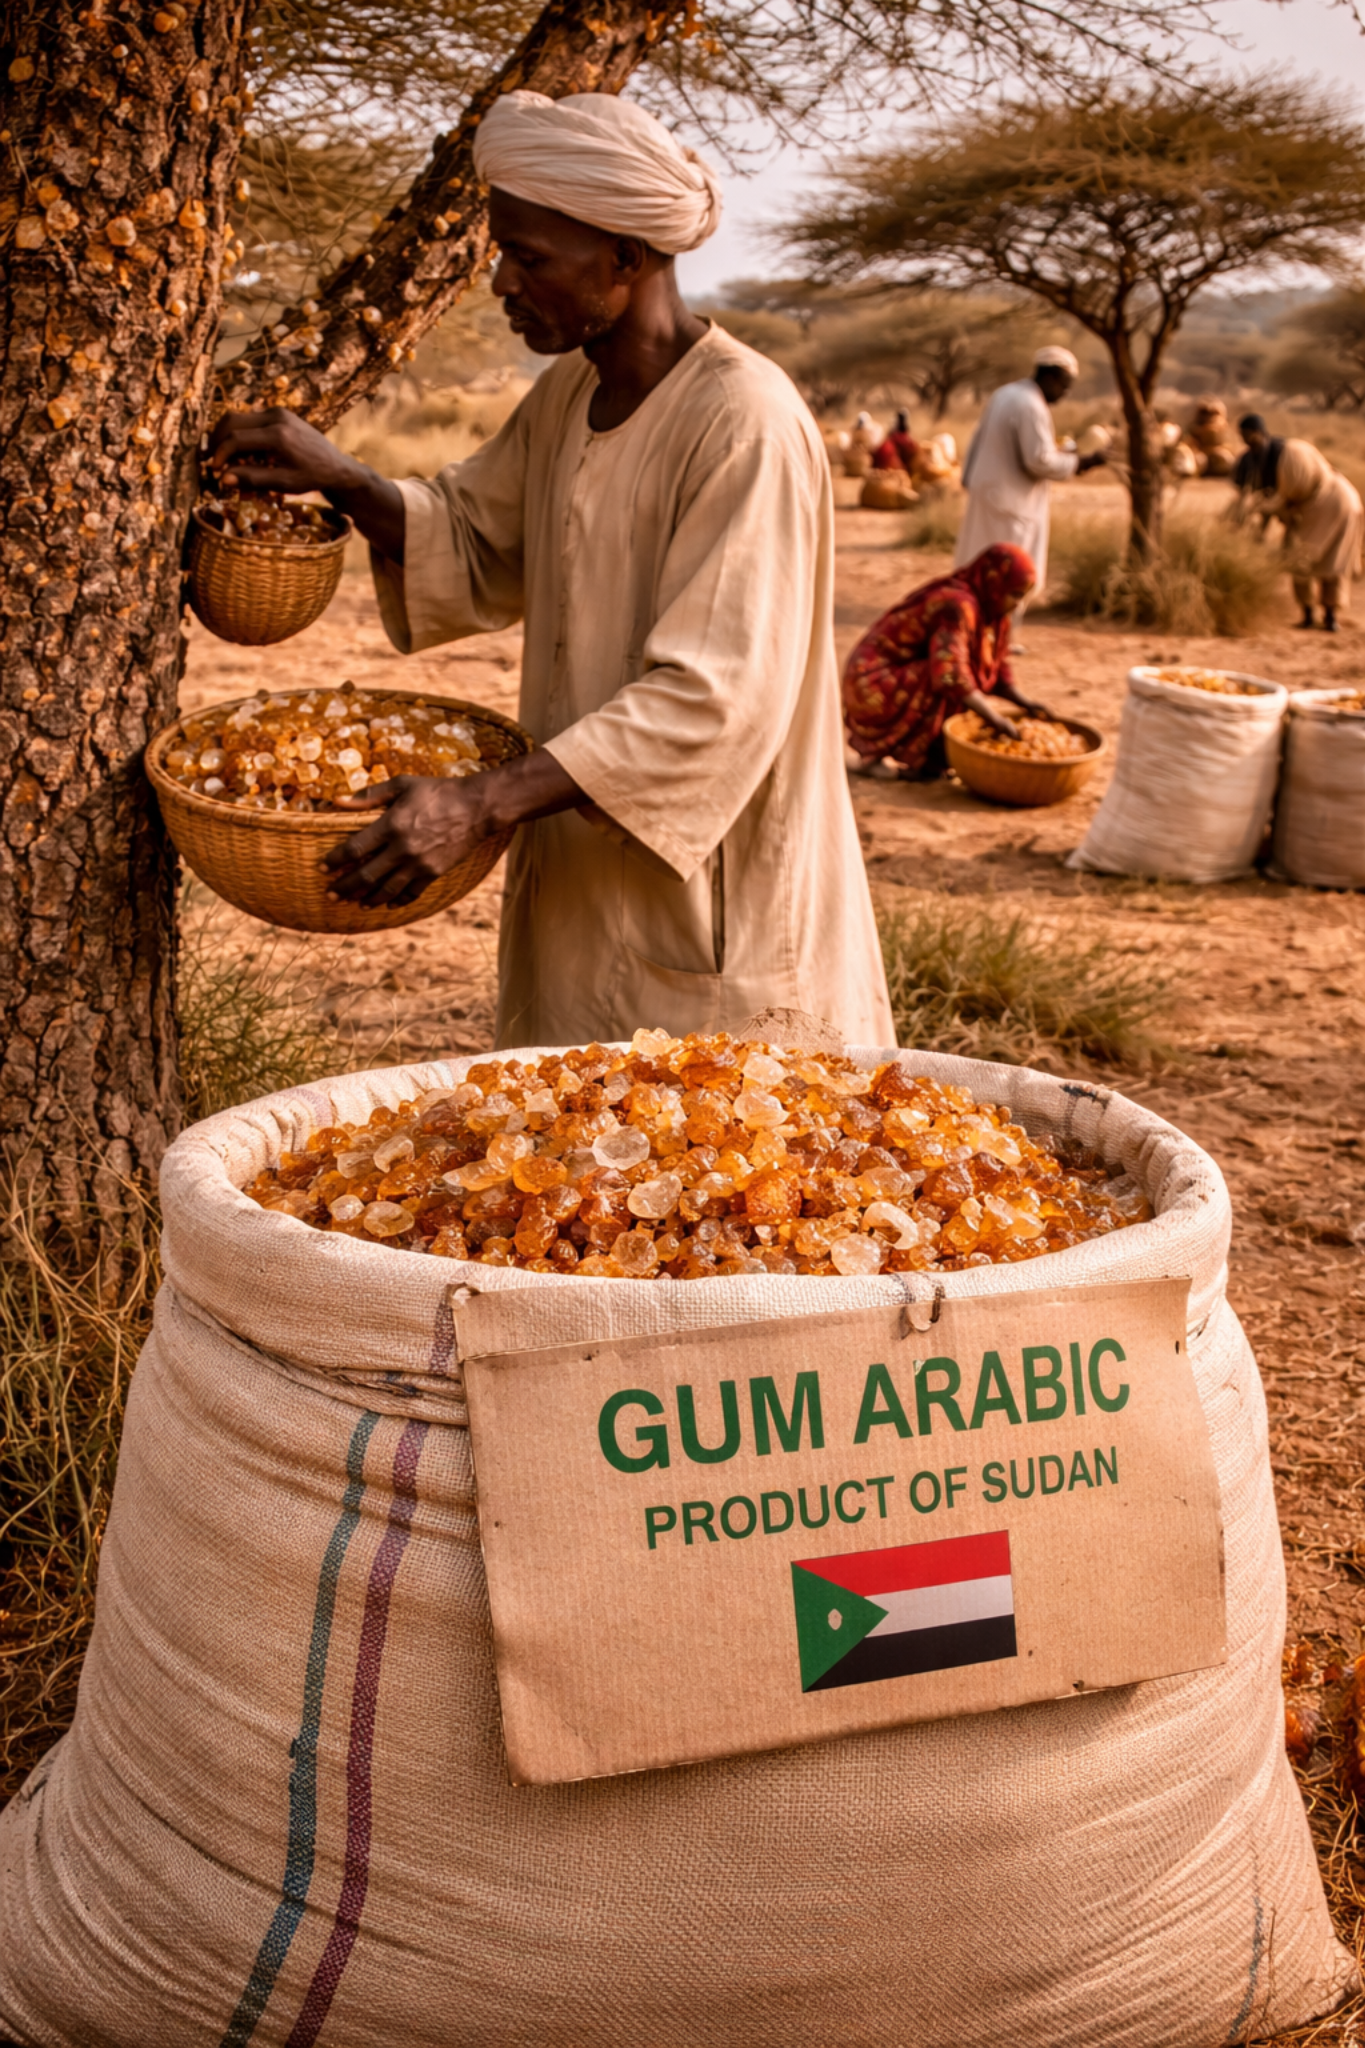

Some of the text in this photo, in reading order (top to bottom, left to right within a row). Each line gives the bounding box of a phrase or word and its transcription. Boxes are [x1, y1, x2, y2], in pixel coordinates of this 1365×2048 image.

[597, 1337, 1130, 1474] GUM ARABIC
[645, 1445, 1120, 1549] PRODUCT OF SUDAN
